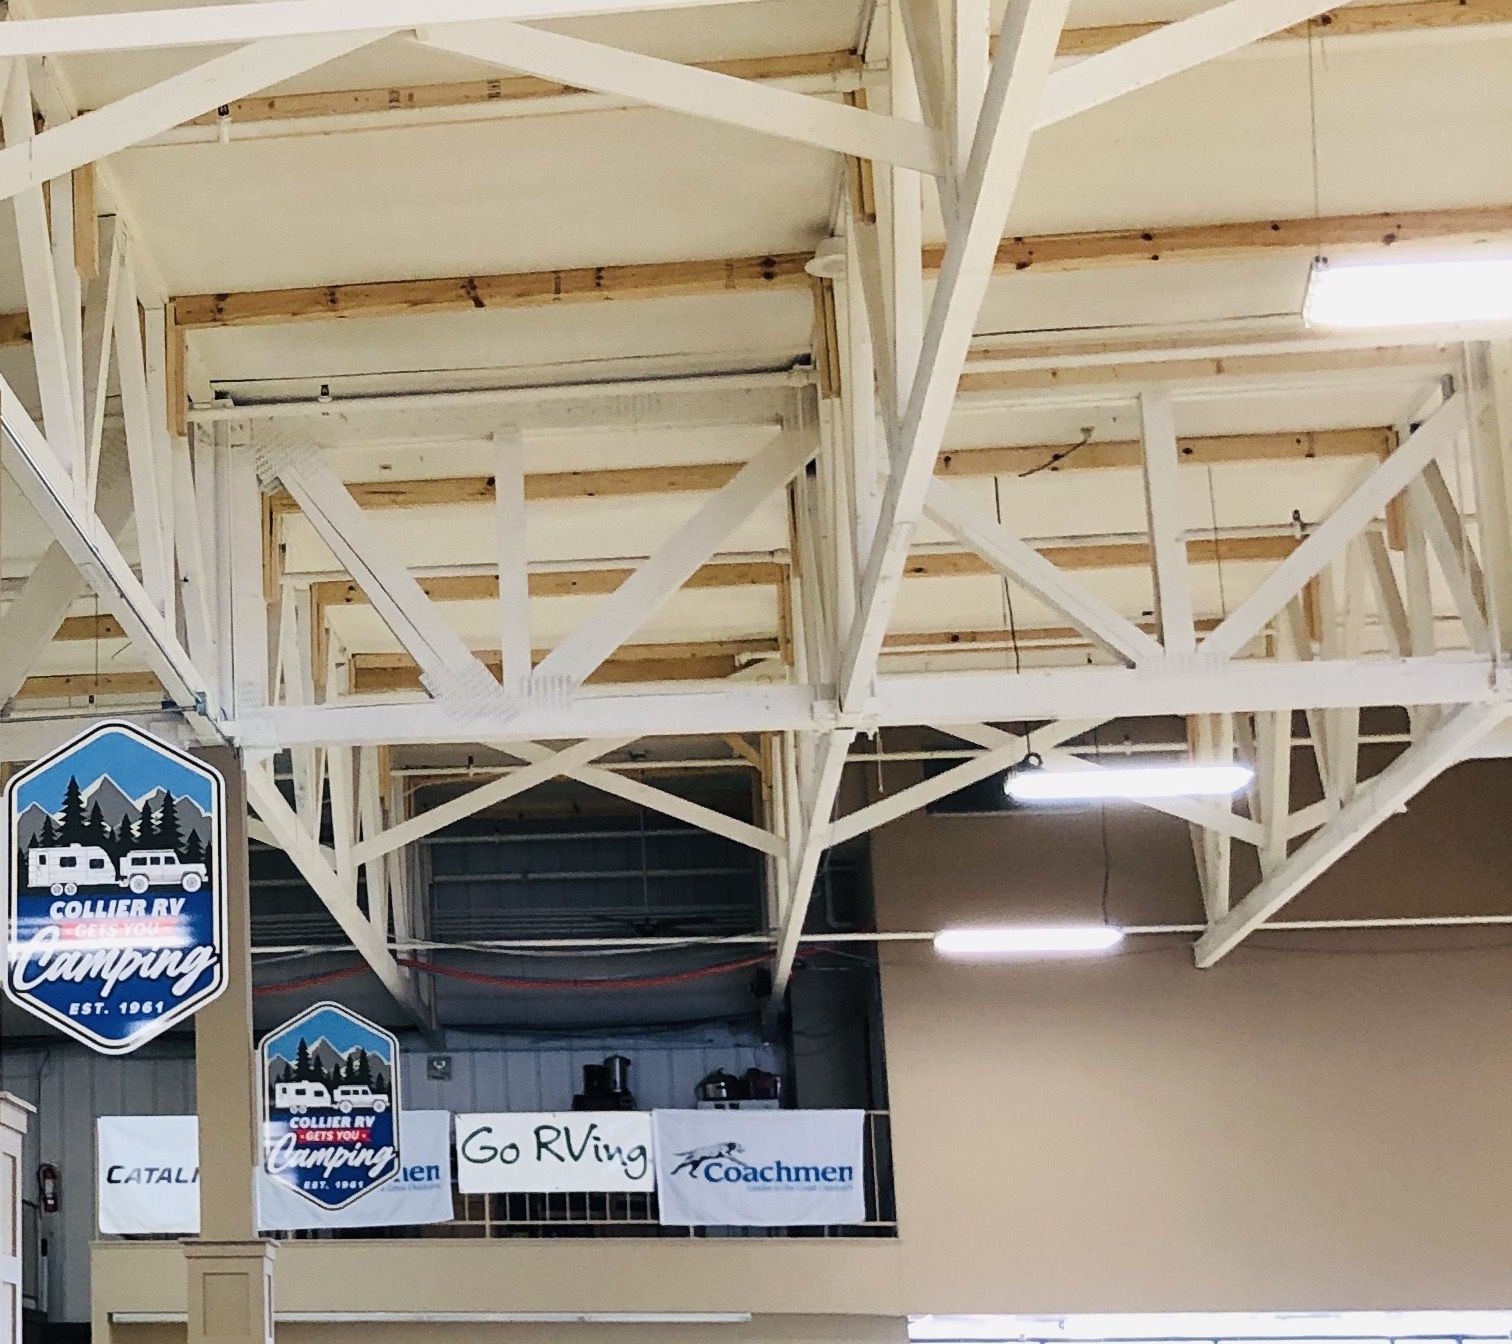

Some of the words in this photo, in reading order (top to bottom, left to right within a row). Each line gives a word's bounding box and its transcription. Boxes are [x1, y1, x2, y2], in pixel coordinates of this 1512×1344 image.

[49, 898, 148, 920] COLLIER
[151, 897, 186, 917] RV
[75, 922, 120, 938] GETS
[123, 921, 160, 936] YOU
[13, 925, 217, 998] Camping
[69, 1002, 109, 1016] EST.
[118, 1001, 165, 1014] 1961
[289, 1116, 352, 1129] COLLIER
[353, 1115, 376, 1128] RV
[305, 1130, 334, 1142] GETS
[335, 1130, 360, 1142] YOU
[268, 1132, 396, 1178] Camping
[461, 1126, 520, 1164] Go
[534, 1123, 648, 1180] RVing
[703, 1159, 853, 1184] Coachmen
